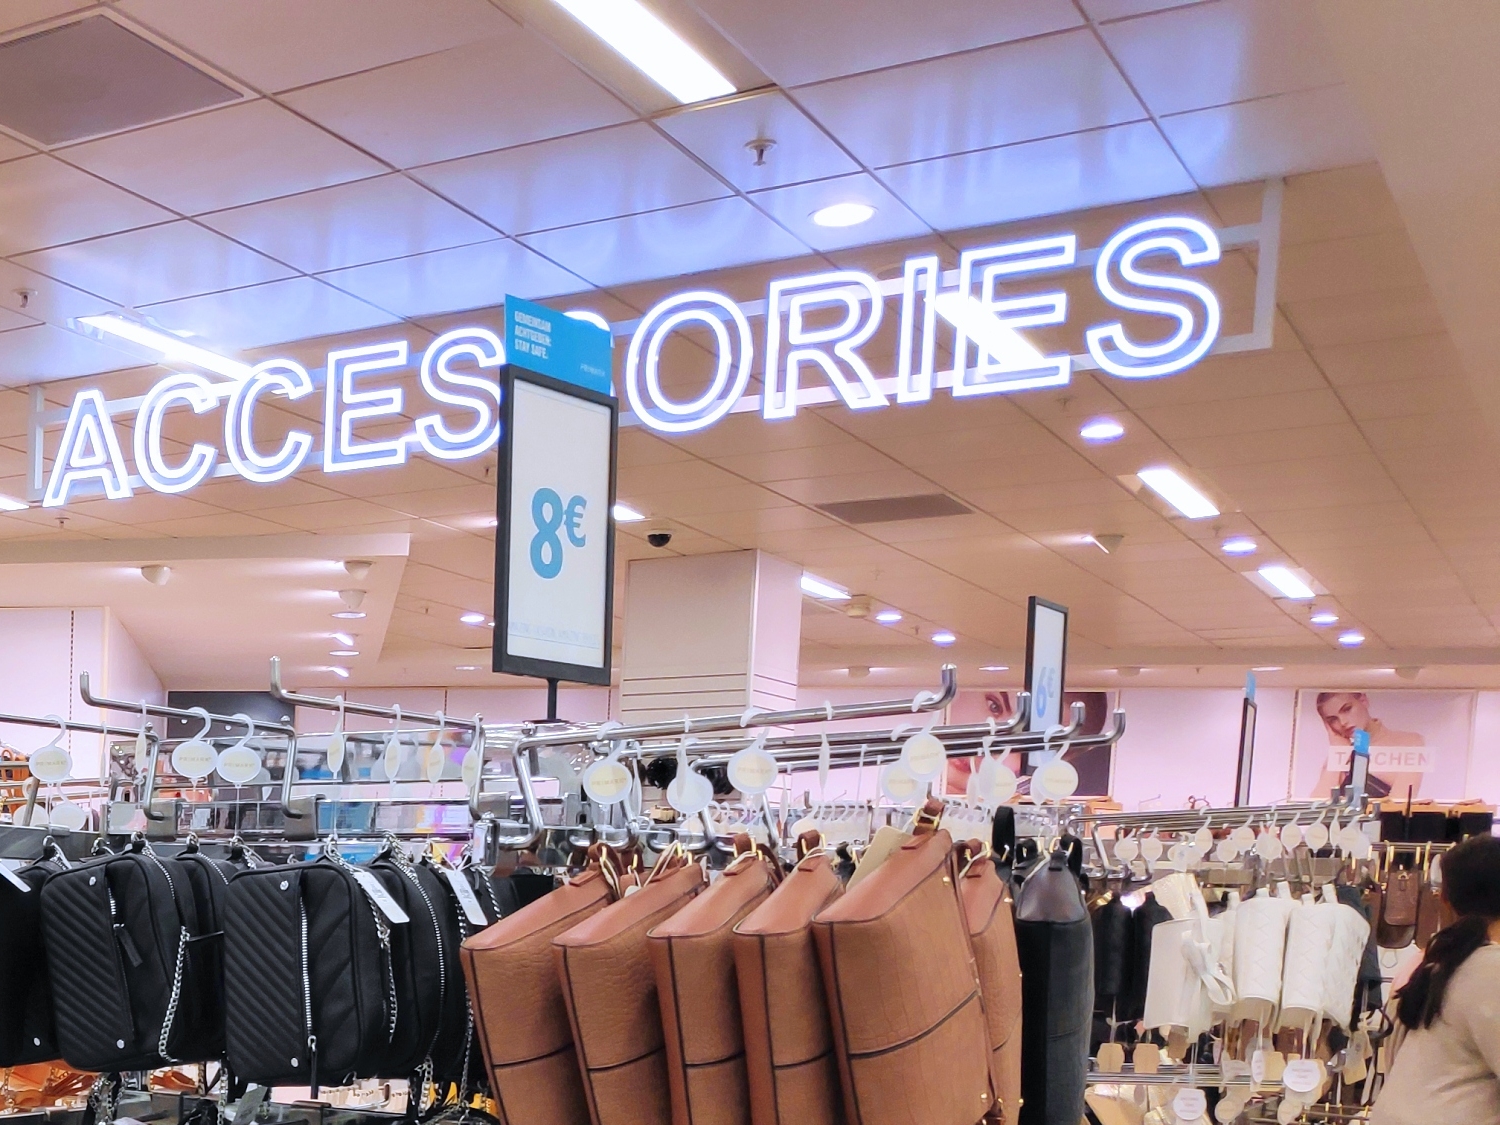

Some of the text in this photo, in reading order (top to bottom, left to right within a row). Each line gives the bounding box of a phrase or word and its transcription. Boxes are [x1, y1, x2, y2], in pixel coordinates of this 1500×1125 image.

[42, 217, 1220, 507] ACCESORIES
[530, 487, 587, 579] 8€
[1036, 666, 1056, 718] 6€
[1335, 751, 1430, 766] TCHEN
